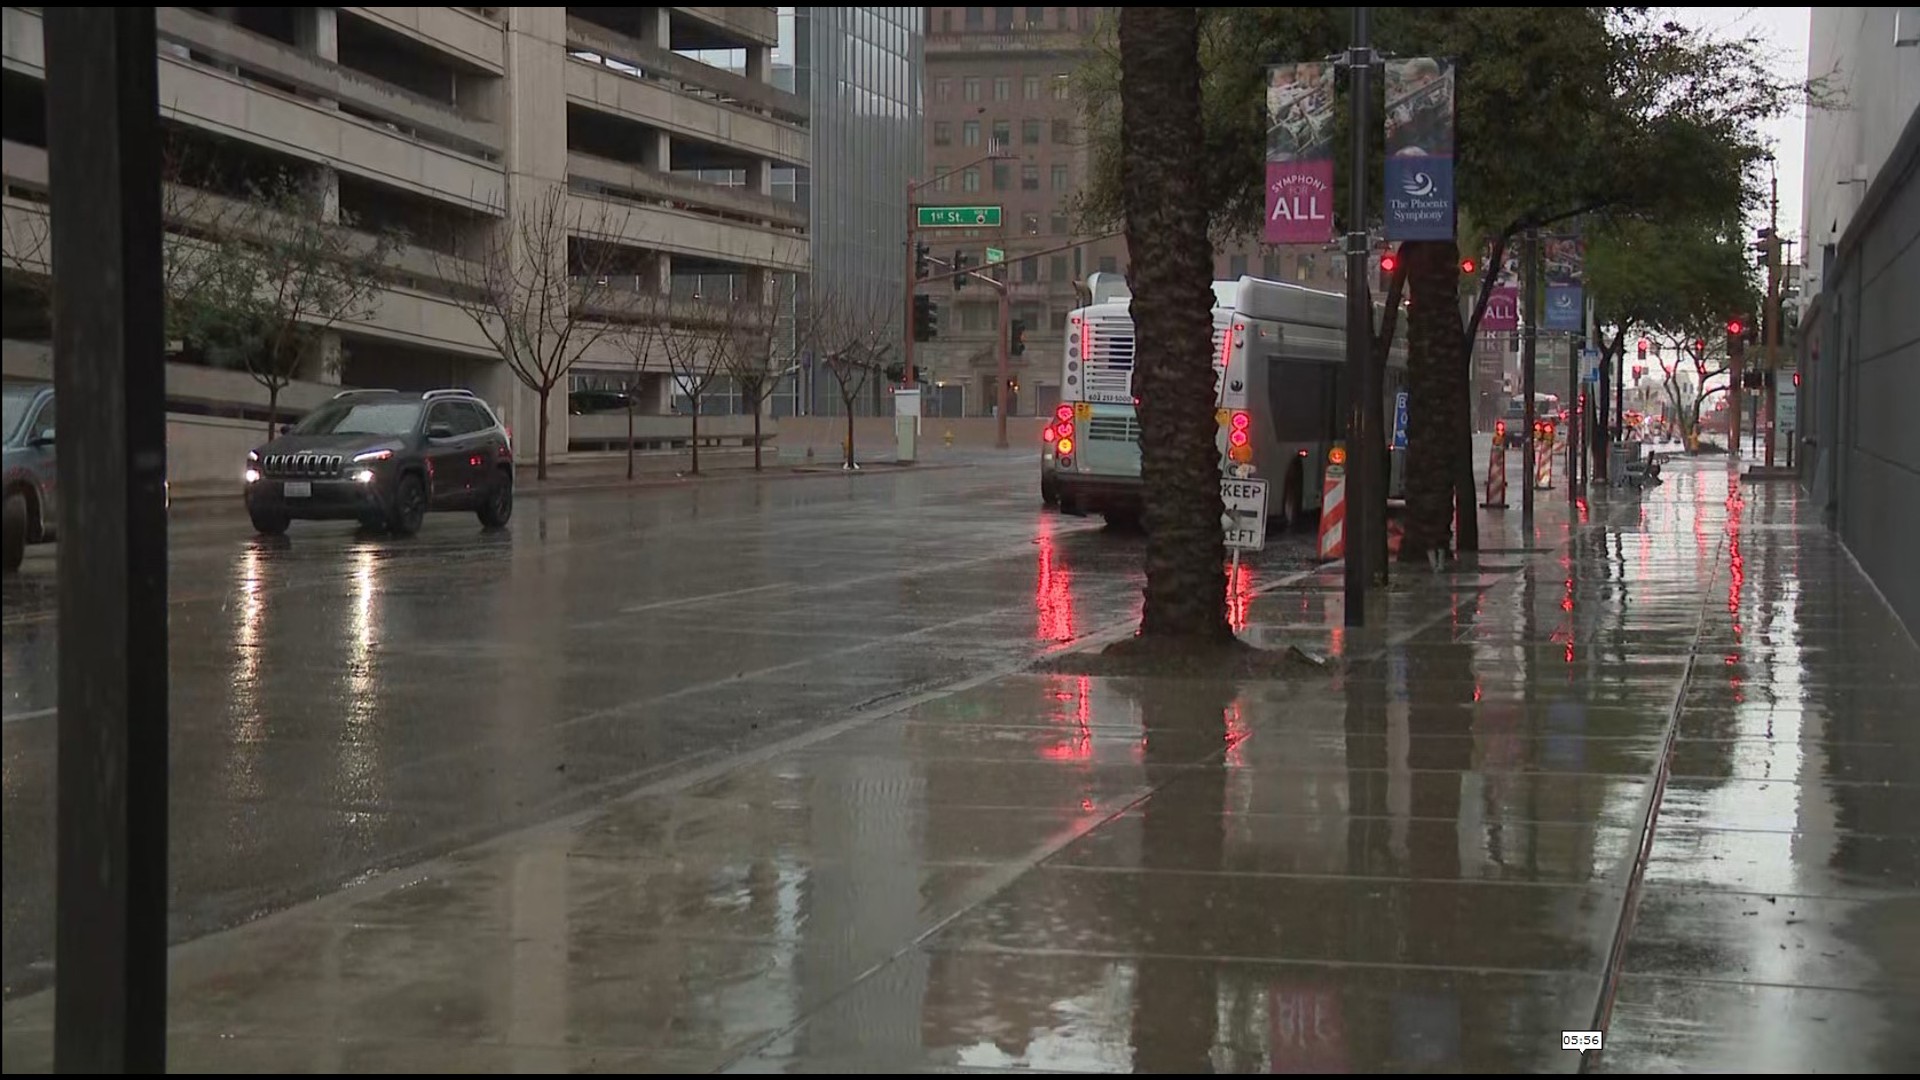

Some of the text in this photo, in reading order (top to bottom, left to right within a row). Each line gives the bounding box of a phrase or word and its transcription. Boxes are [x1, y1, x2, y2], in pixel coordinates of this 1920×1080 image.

[1271, 174, 1327, 193] SYMPHONY
[1271, 196, 1325, 220] ALL
[1390, 199, 1449, 209] The Phoenix
[931, 211, 964, 222] 1st St.
[1394, 210, 1444, 222] Symphony
[1484, 306, 1514, 319] ALL
[1222, 483, 1262, 499] KEEP
